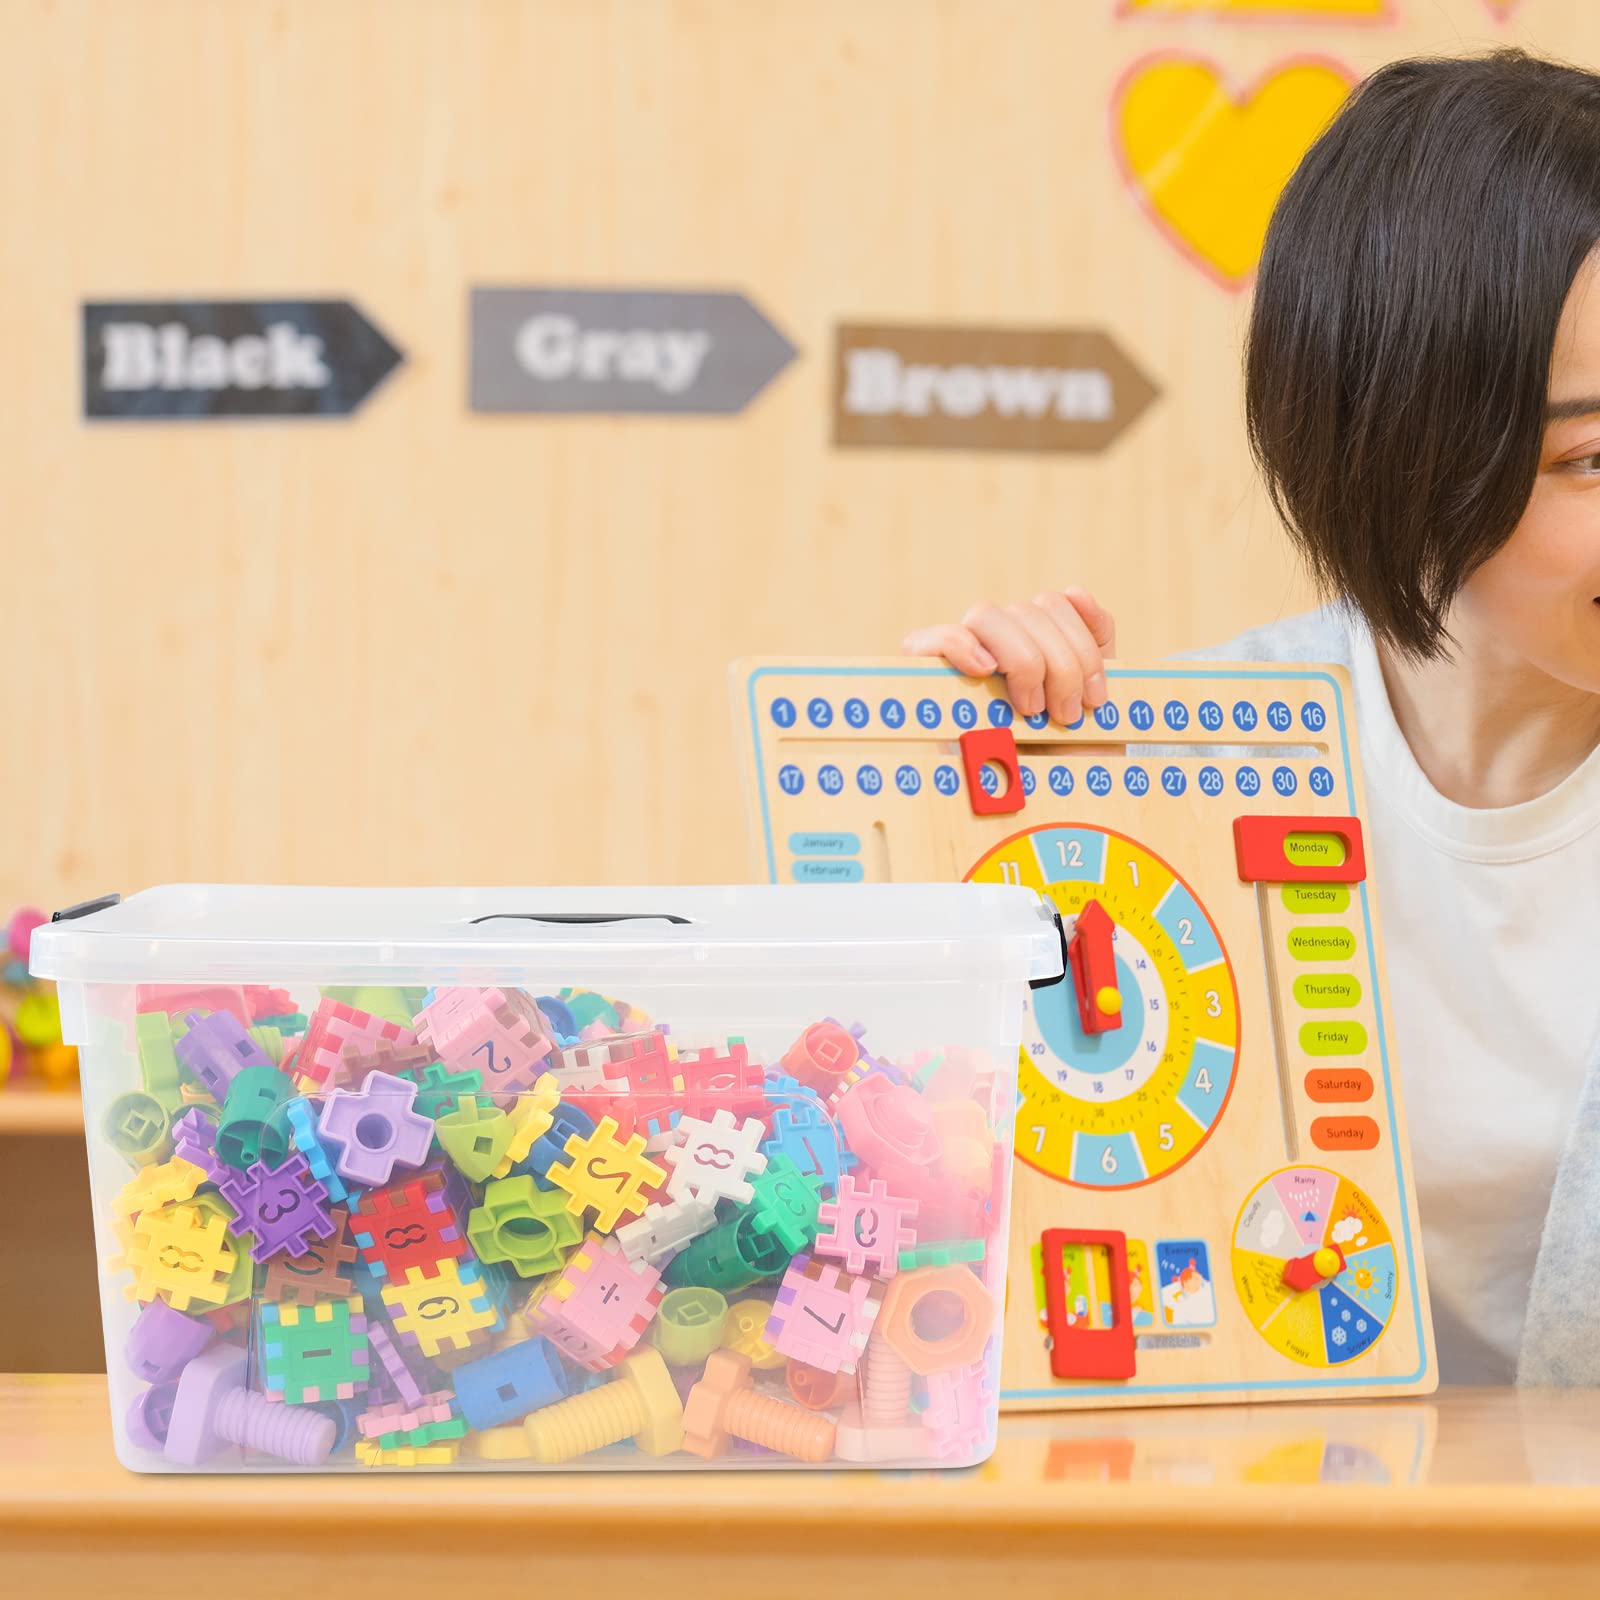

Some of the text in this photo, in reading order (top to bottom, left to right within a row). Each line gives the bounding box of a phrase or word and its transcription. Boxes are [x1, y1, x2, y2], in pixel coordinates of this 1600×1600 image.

[103, 321, 332, 391] Black
[514, 313, 711, 394] Gray
[845, 347, 1115, 421] Brown
[776, 703, 788, 722] 1
[814, 703, 828, 722] 2
[850, 703, 864, 722] 3
[886, 704, 900, 722] 4
[922, 704, 936, 723] 5
[958, 704, 972, 723] 6
[994, 705, 1007, 723] 7
[1097, 705, 1117, 724] 10
[1131, 706, 1150, 725] 11
[1166, 706, 1186, 725] 12
[1201, 706, 1220, 725] 13
[1236, 707, 1255, 725] 14
[1270, 707, 1289, 725] 15
[1304, 707, 1323, 726] 16
[781, 769, 800, 789] 17
[820, 770, 840, 789] 18
[859, 770, 879, 789] 19
[899, 771, 919, 789] 20
[937, 771, 956, 789] 21
[1051, 771, 1072, 790] 24
[1089, 771, 1110, 790] 25
[1127, 771, 1148, 790] 26
[1164, 771, 1185, 790] 27
[1201, 772, 1222, 790] 28
[1239, 772, 1259, 790] 29
[1276, 772, 1295, 791] 30
[1313, 772, 1331, 791] 31
[802, 837, 844, 850] January
[1290, 841, 1329, 854] Monday
[1056, 840, 1085, 868] 12
[803, 865, 851, 877] February
[999, 861, 1021, 886] 11
[1127, 861, 1140, 888] 1
[1294, 889, 1337, 901] Tuesday
[1177, 917, 1195, 946] 2
[1292, 937, 1350, 948] Wednesday
[1135, 959, 1147, 971] 14
[1304, 984, 1351, 996] Thursday
[1149, 999, 1159, 1011] 15
[1204, 990, 1222, 1018] 3
[1317, 1031, 1349, 1043] Friday
[1031, 1043, 1045, 1055] 20
[1146, 1041, 1157, 1053] 16
[1057, 1070, 1067, 1082] 19
[1125, 1070, 1135, 1081] 17
[1194, 1067, 1213, 1094] 4
[1093, 1081, 1104, 1093] 18
[1316, 1079, 1362, 1091] Saturday
[1031, 1125, 1047, 1153] 7
[1158, 1123, 1175, 1151] 5
[1326, 1128, 1364, 1140] Sunday
[1101, 1145, 1118, 1173] 6
[1294, 1176, 1316, 1185] Rainy
[1352, 1191, 1380, 1226] Overcast
[1385, 1271, 1395, 1300] Sunny
